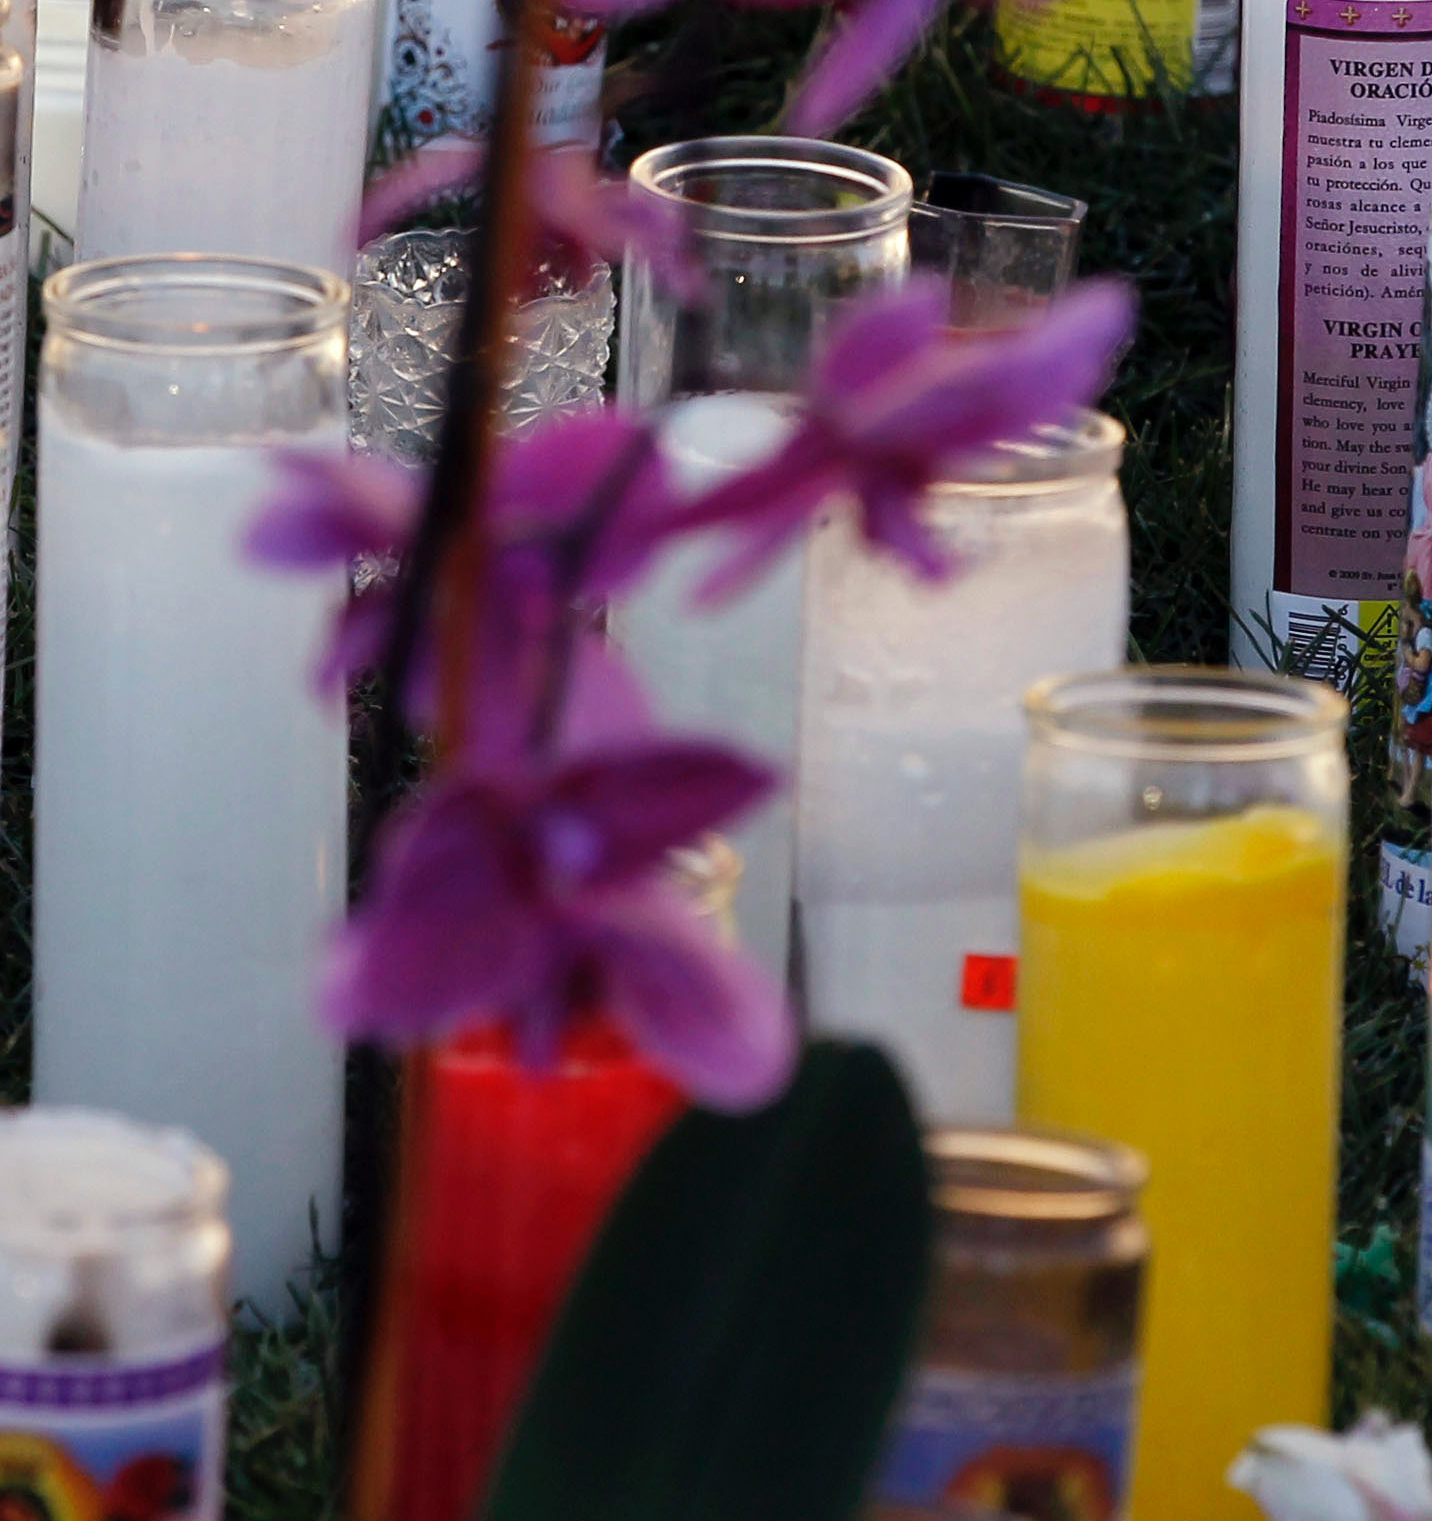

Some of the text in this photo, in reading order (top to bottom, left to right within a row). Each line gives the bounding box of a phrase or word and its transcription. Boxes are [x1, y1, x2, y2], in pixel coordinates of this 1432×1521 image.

[1329, 59, 1414, 78] VIRGEN
[1308, 108, 1386, 127] Piadosísima
[1307, 135, 1362, 148] muestra
[1369, 138, 1383, 148] tu
[1307, 154, 1427, 173] pasión a los que
[1307, 176, 1432, 193] tu protección. Qu
[1306, 198, 1421, 212] rosas alcance a
[1305, 216, 1422, 236] Señor Jesucristo,
[1305, 241, 1427, 259] oraciónes, seq
[1305, 263, 1425, 277] y nos de alivi
[1305, 282, 1425, 301] petición). Amén
[1323, 319, 1422, 339] VIRGIN O
[1351, 343, 1421, 359] PRAYE
[1303, 371, 1410, 393] Merciful Virgin
[1303, 393, 1404, 413] clemency, love
[1303, 416, 1412, 435] who love you a
[1303, 436, 1410, 456] tion. May the sw
[1302, 460, 1330, 472] your
[1334, 460, 1376, 474] divine
[1302, 479, 1408, 499] He may hear o
[1301, 501, 1406, 519] and give us co
[1301, 524, 1408, 543] centrate on yo
[1396, 870, 1414, 899] de
